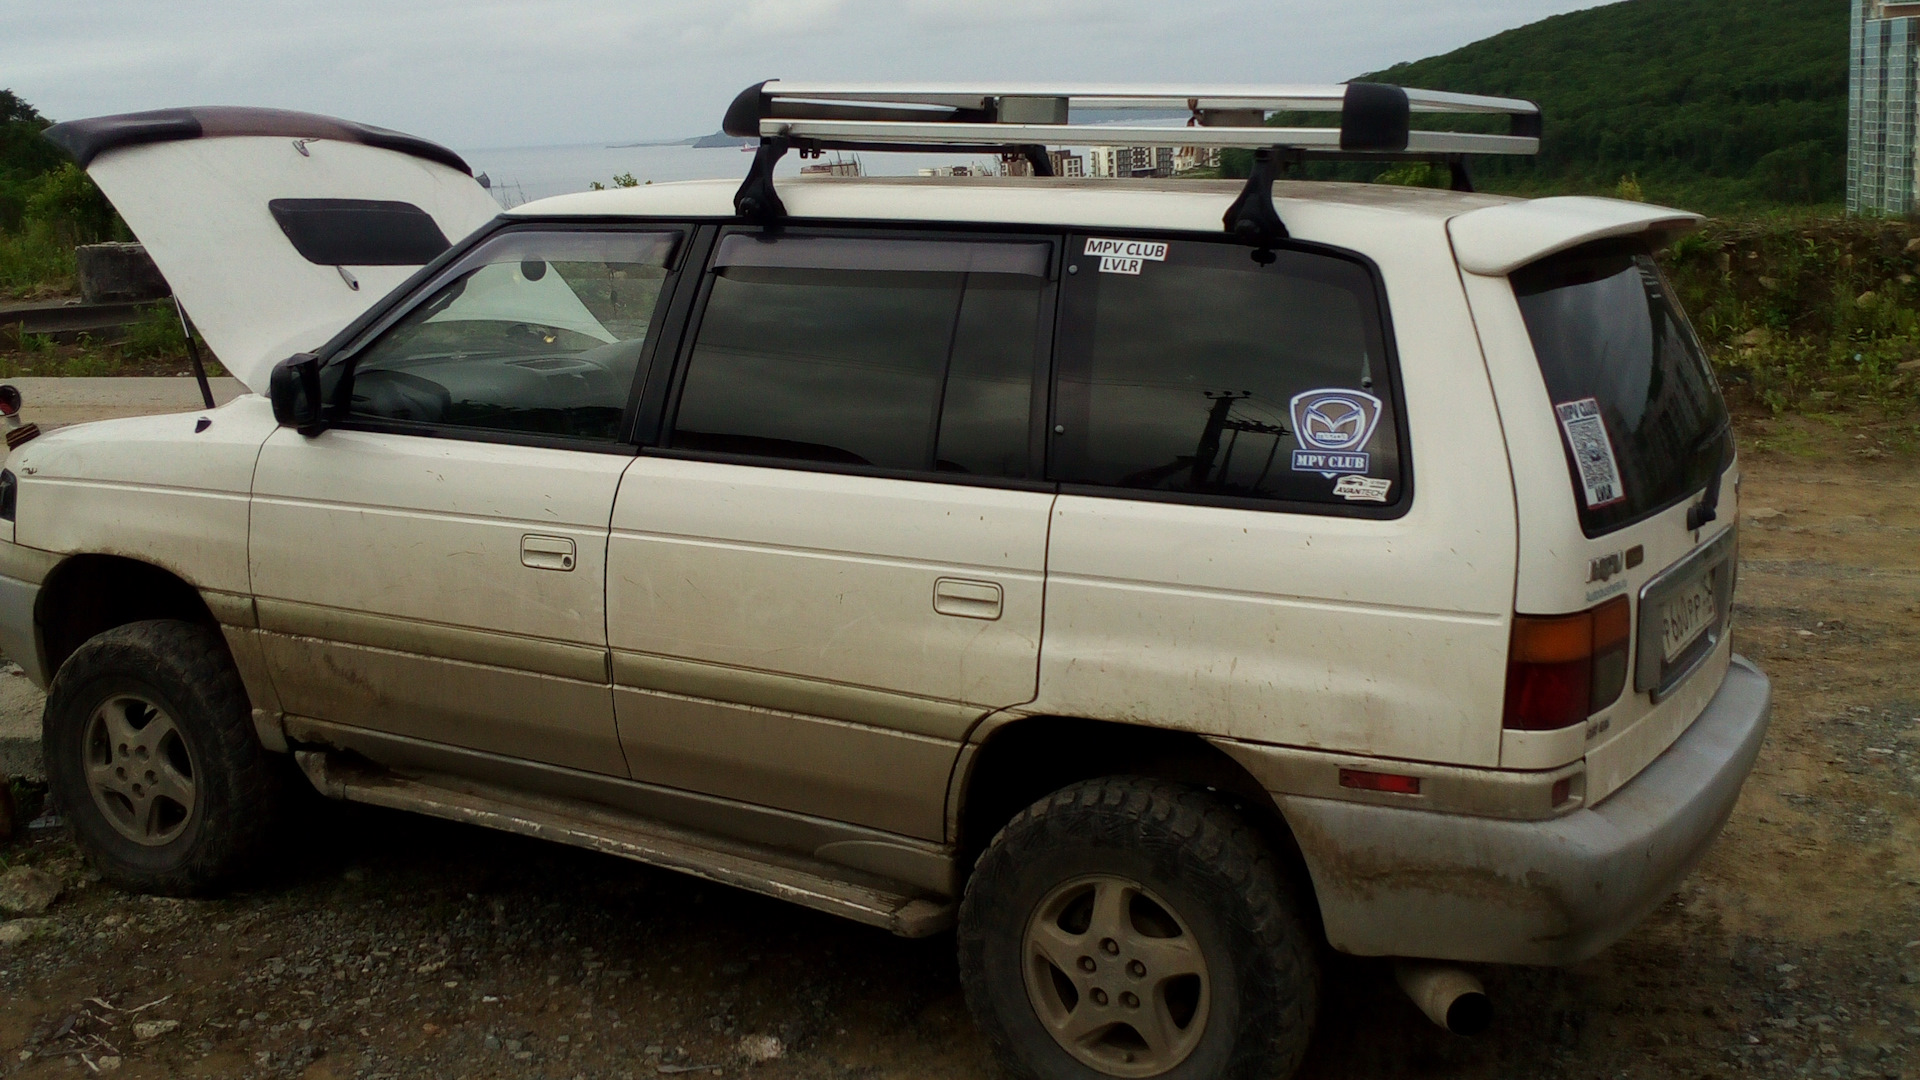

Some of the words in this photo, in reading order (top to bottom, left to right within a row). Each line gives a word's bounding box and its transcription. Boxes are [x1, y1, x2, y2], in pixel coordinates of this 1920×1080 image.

[1087, 240, 1123, 254] MPV
[1126, 243, 1165, 257] CLUB
[1103, 258, 1139, 272] LVLR
[1296, 454, 1326, 467] MPV
[1327, 456, 1366, 469] CLUB
[1336, 486, 1385, 497] AVANTECH
